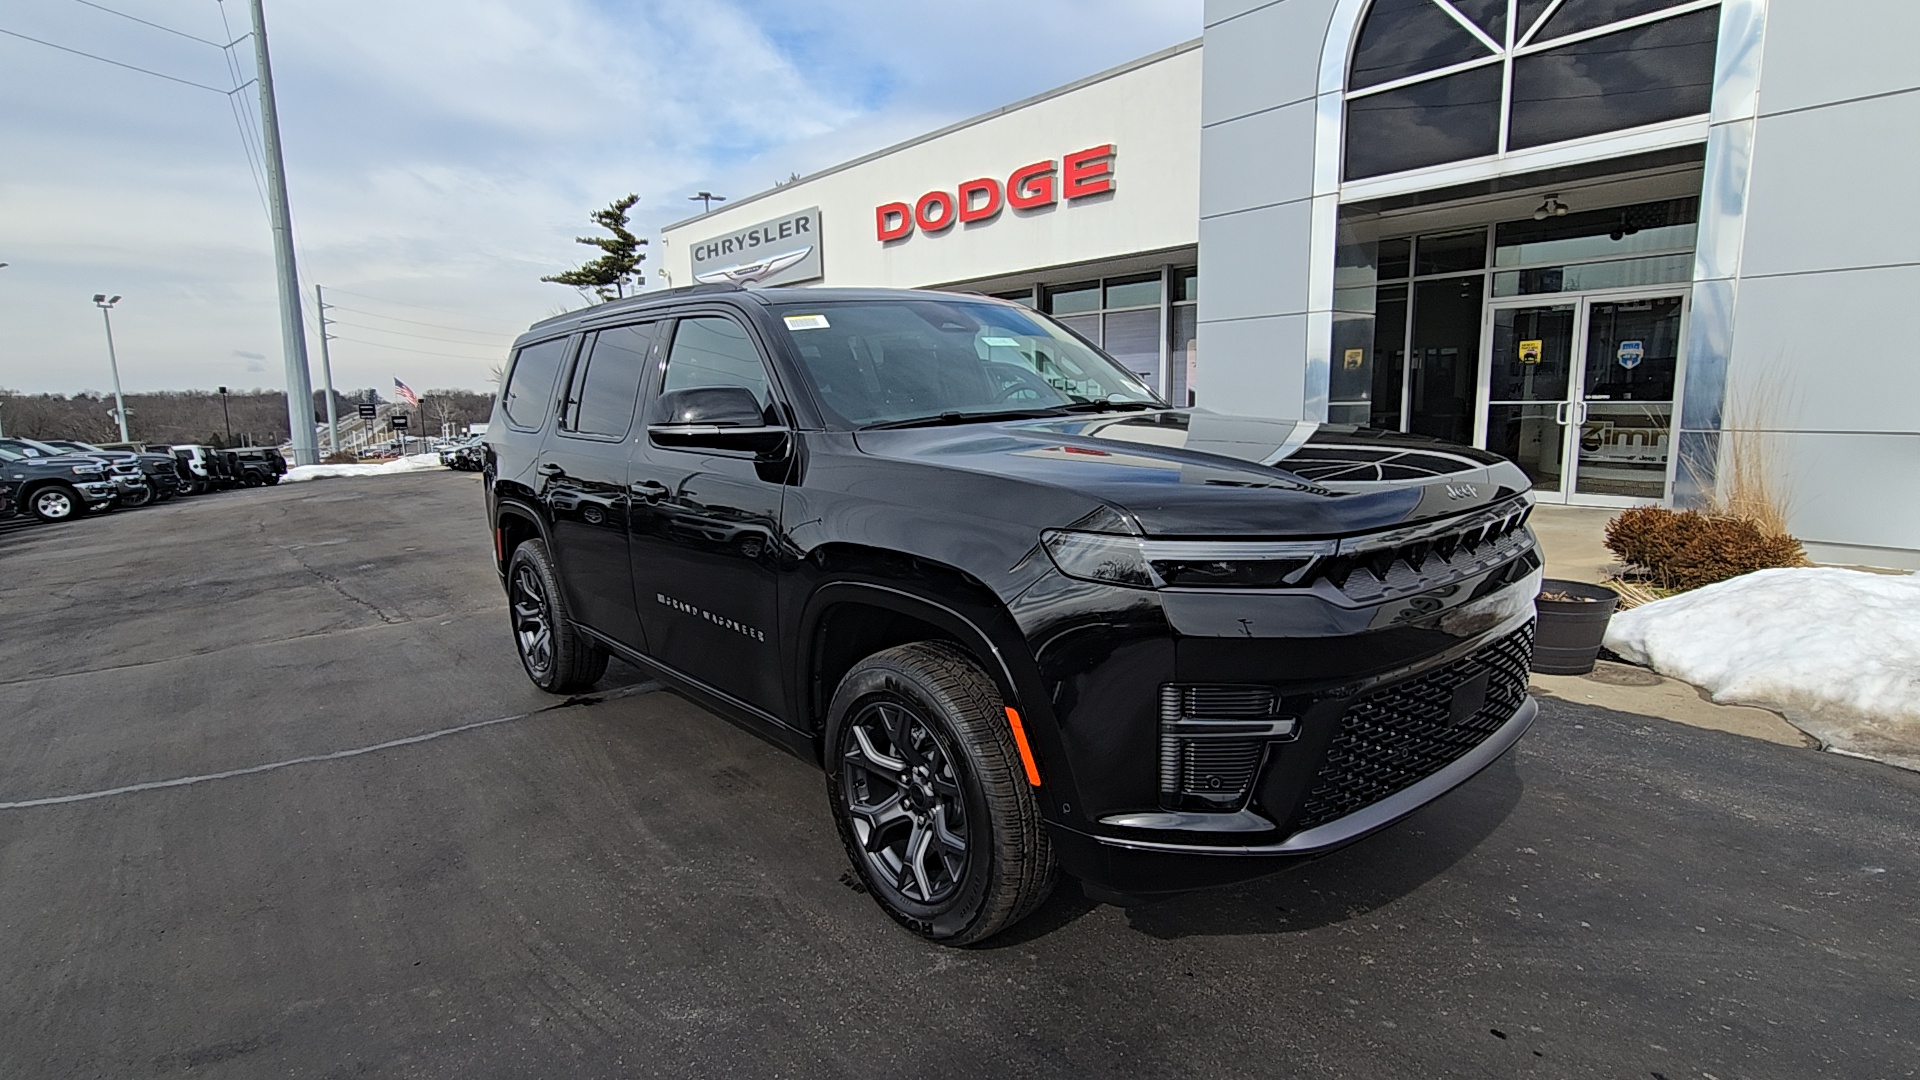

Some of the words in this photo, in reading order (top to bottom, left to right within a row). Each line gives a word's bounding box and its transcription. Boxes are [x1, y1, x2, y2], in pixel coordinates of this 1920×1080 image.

[876, 144, 1117, 243] DODGE
[694, 215, 811, 262] CHRYSLER
[1445, 483, 1478, 500] Jeep
